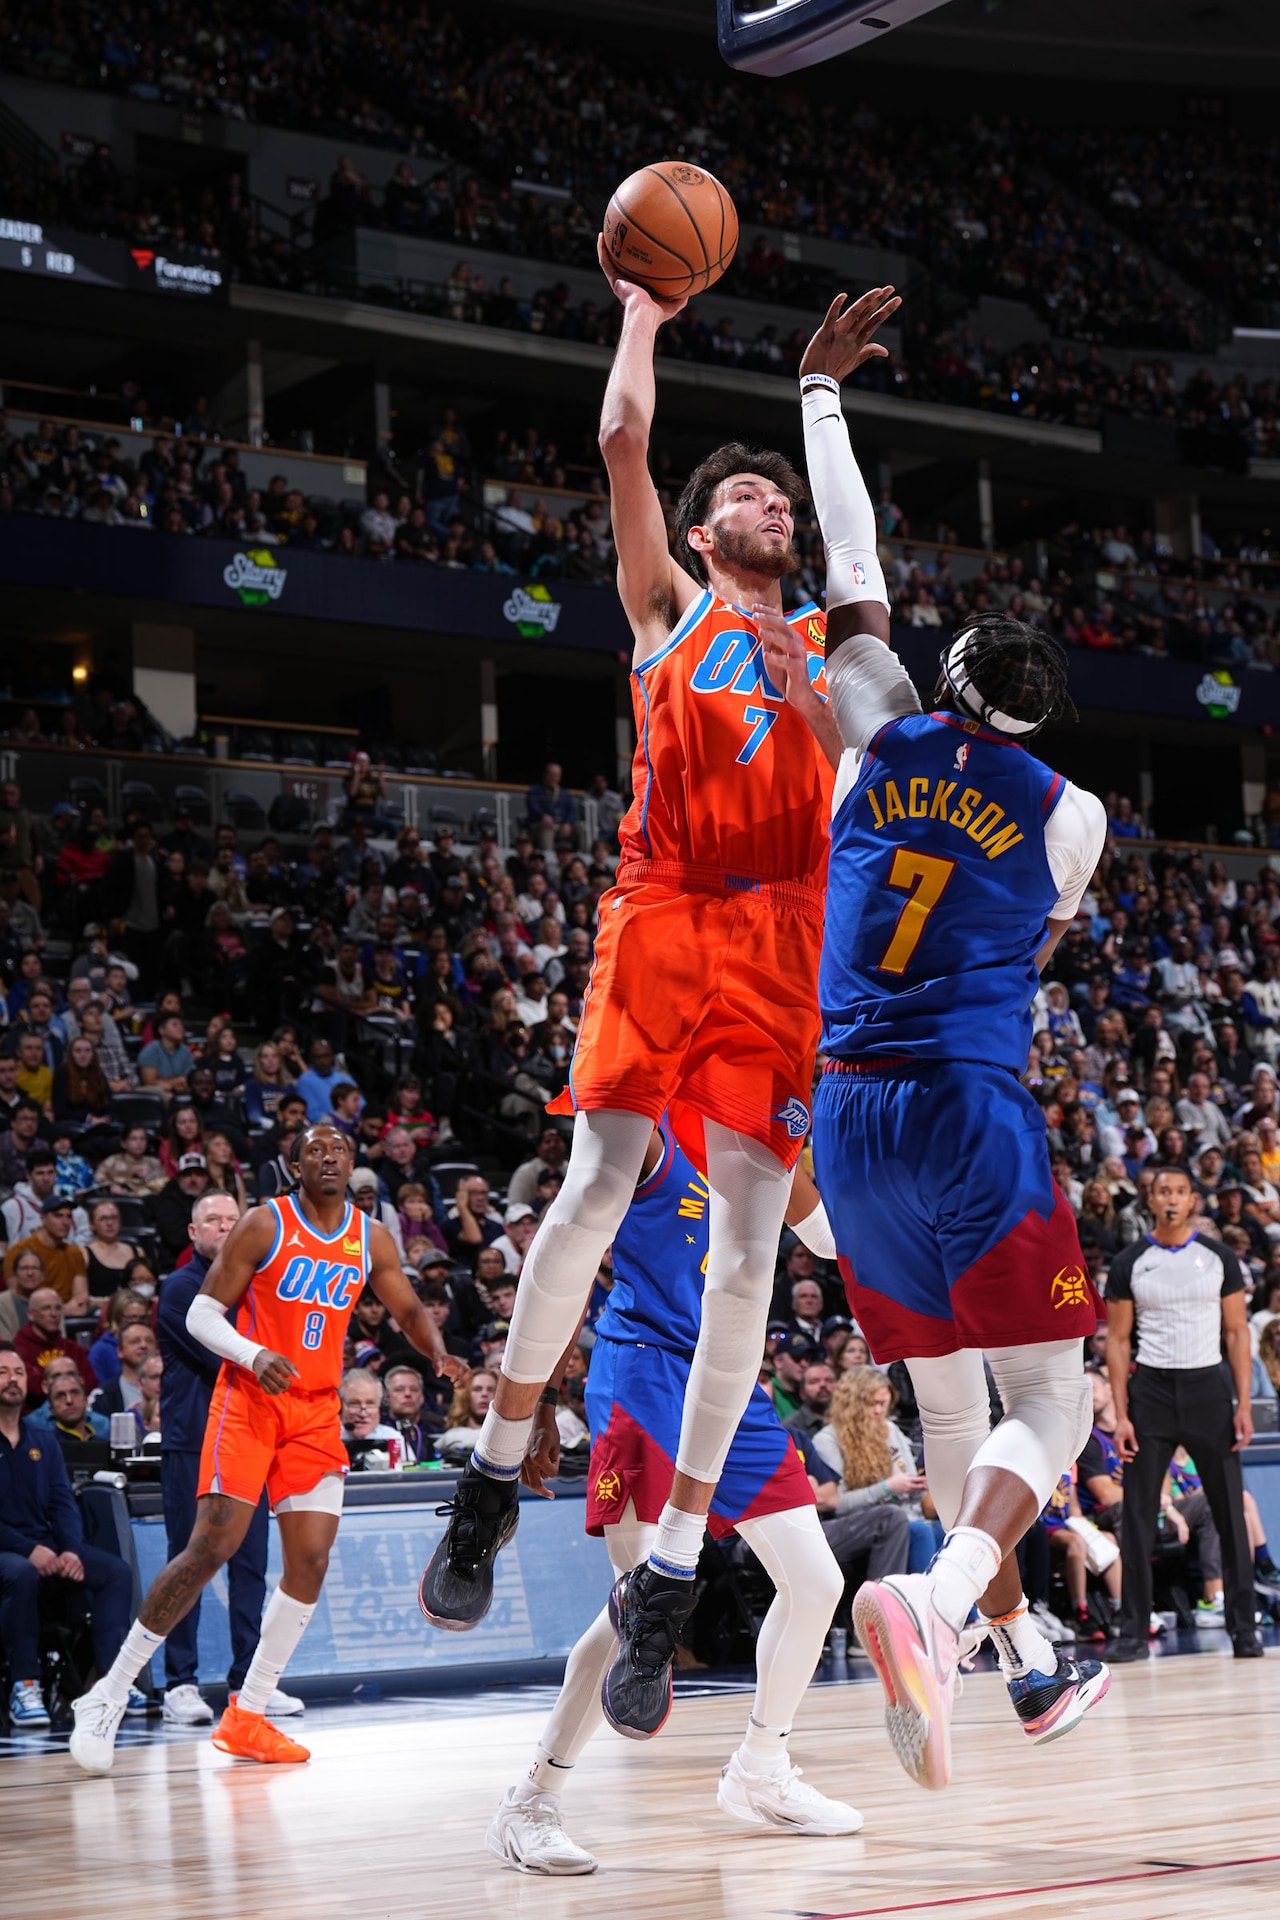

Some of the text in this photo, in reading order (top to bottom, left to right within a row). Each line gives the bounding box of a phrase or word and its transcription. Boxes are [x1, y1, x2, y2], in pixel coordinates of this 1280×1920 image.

[0, 218, 43, 244] EADER
[155, 256, 222, 286] Fanatics
[223, 552, 288, 599] Starry
[503, 587, 561, 632] Starry
[1196, 673, 1241, 713] Starry
[735, 705, 779, 765] 7
[866, 777, 1024, 861] JACKSON
[877, 846, 957, 977] 7
[276, 1255, 361, 1310] OKC
[302, 1310, 325, 1350] 8
